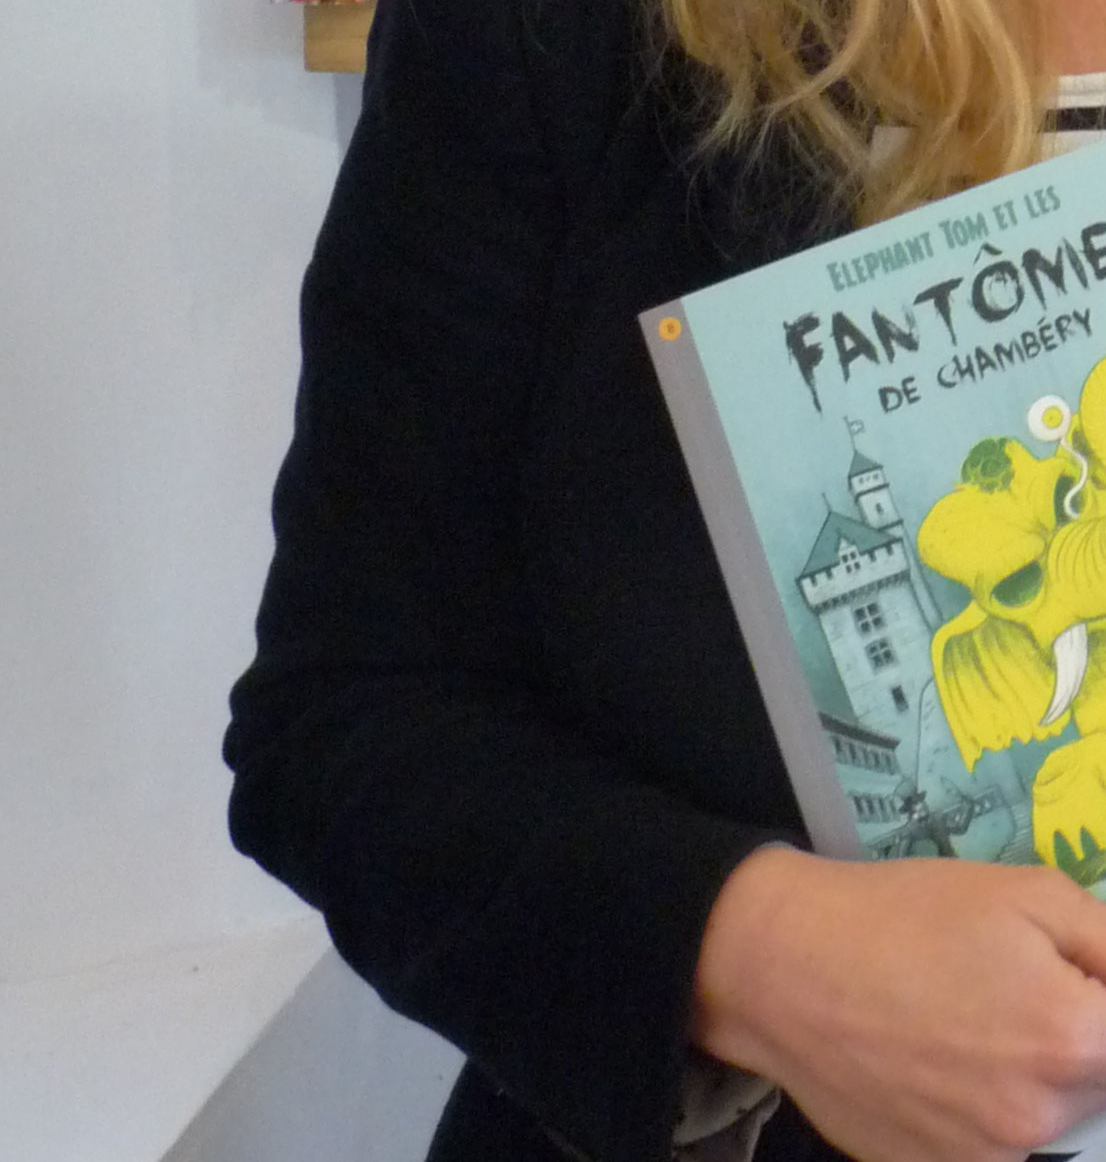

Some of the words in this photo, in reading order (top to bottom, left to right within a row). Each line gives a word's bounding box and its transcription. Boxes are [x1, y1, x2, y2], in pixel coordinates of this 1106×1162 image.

[825, 231, 934, 293] ELEPHANT
[938, 209, 990, 249] TOM
[995, 200, 1019, 231] ET
[1023, 184, 1061, 218] LES
[878, 375, 921, 414] DE
[936, 308, 1094, 390] CHAMBÉRY
